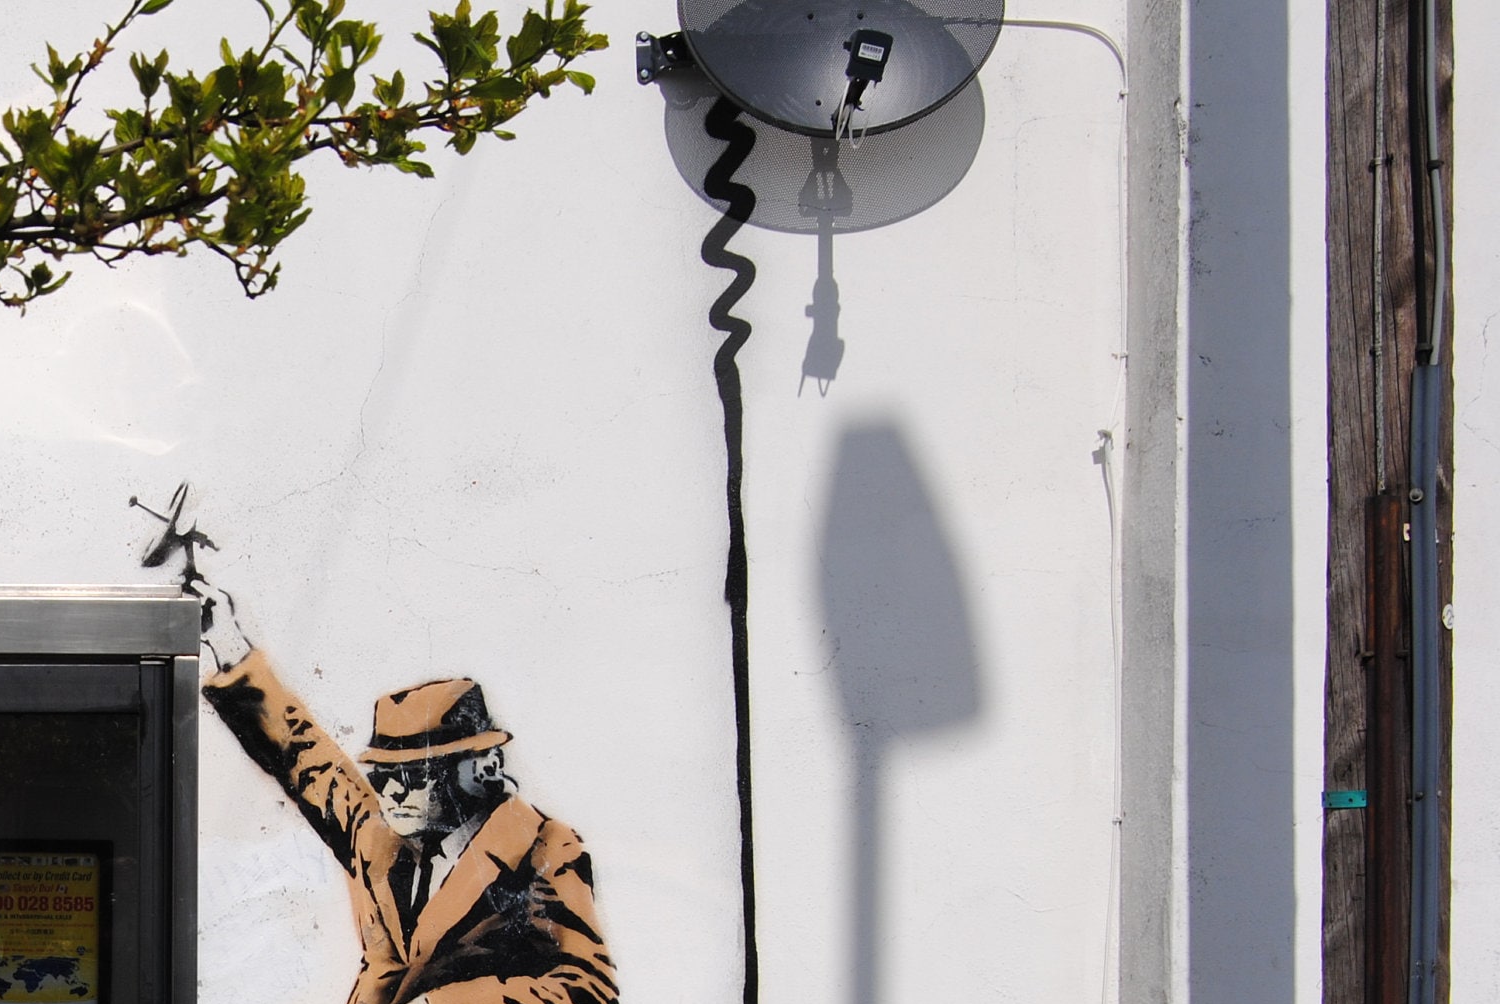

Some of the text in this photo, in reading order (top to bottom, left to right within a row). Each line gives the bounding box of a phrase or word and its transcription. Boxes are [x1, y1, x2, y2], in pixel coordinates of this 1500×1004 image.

[34, 871, 43, 882] by
[45, 872, 70, 881] Credit
[72, 872, 92, 881] Card
[18, 896, 49, 911] 028
[53, 896, 94, 912] 8585
